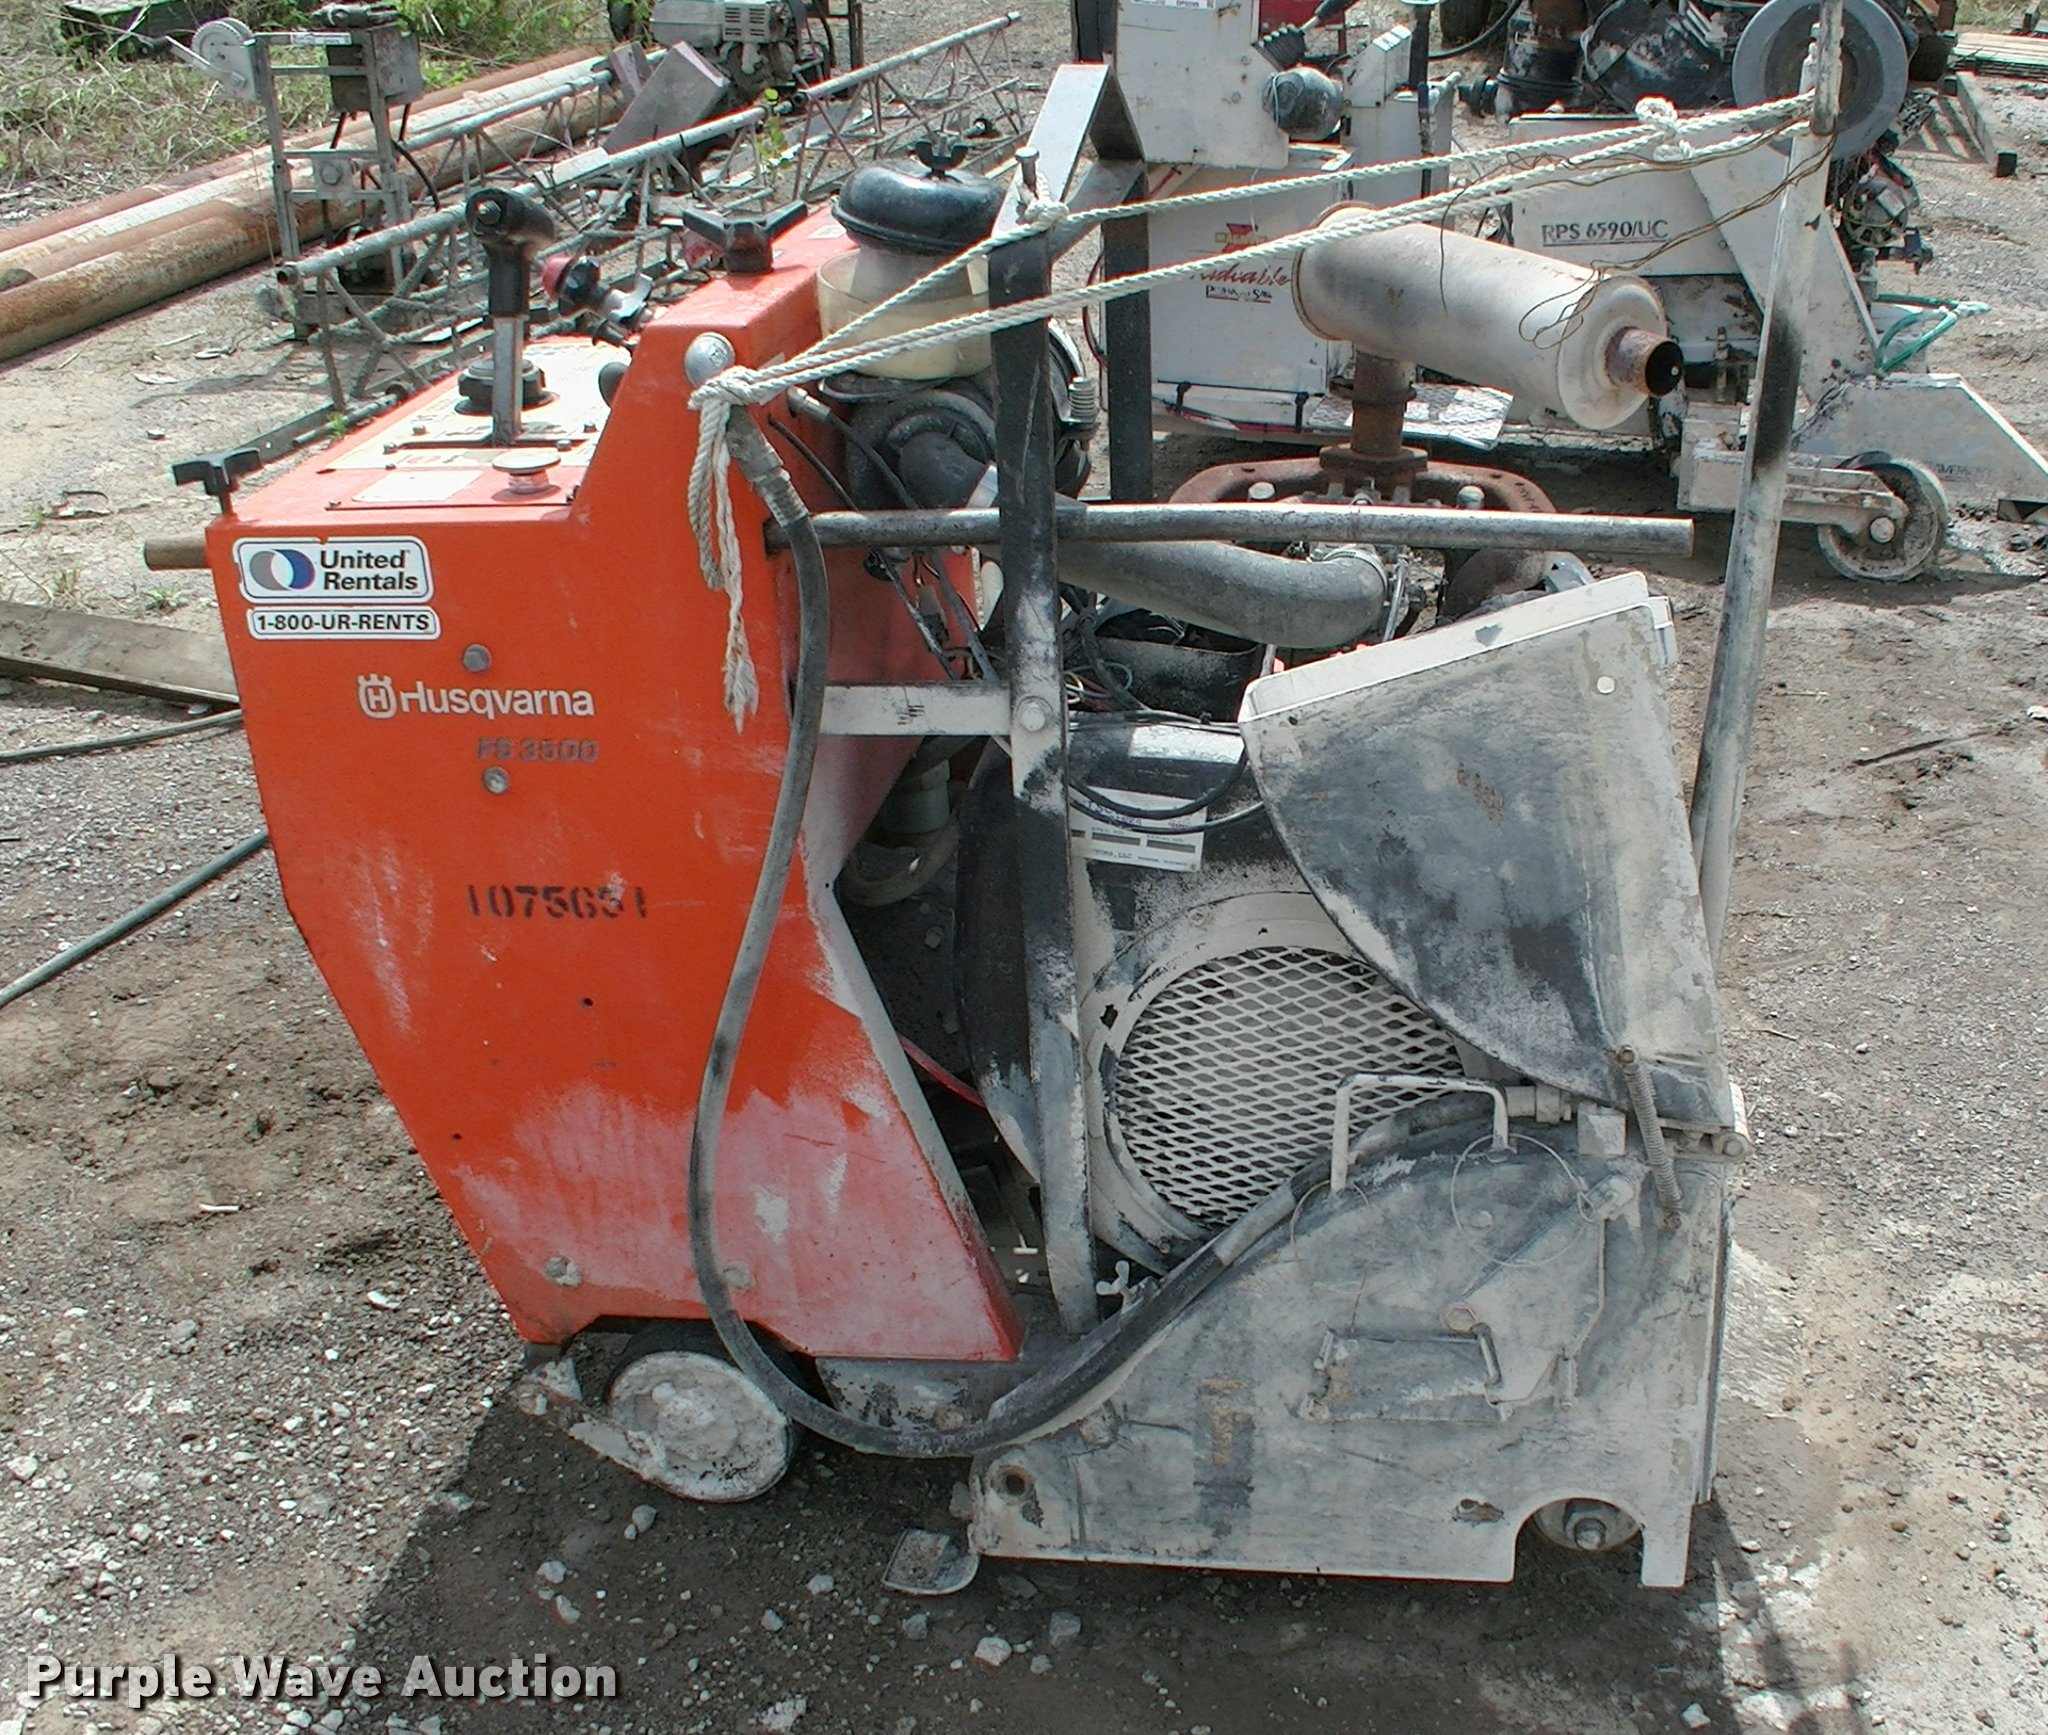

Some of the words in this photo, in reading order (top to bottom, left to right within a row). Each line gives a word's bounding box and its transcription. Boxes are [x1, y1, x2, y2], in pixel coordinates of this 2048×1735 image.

[1541, 223, 1581, 244] RPS
[1586, 219, 1669, 241] 6590/UC
[319, 549, 406, 570] United
[322, 570, 419, 591] Rentals
[257, 613, 431, 631] 1-800-UR-RENTS
[399, 680, 595, 720] Husqvarna
[519, 738, 599, 762] 3500
